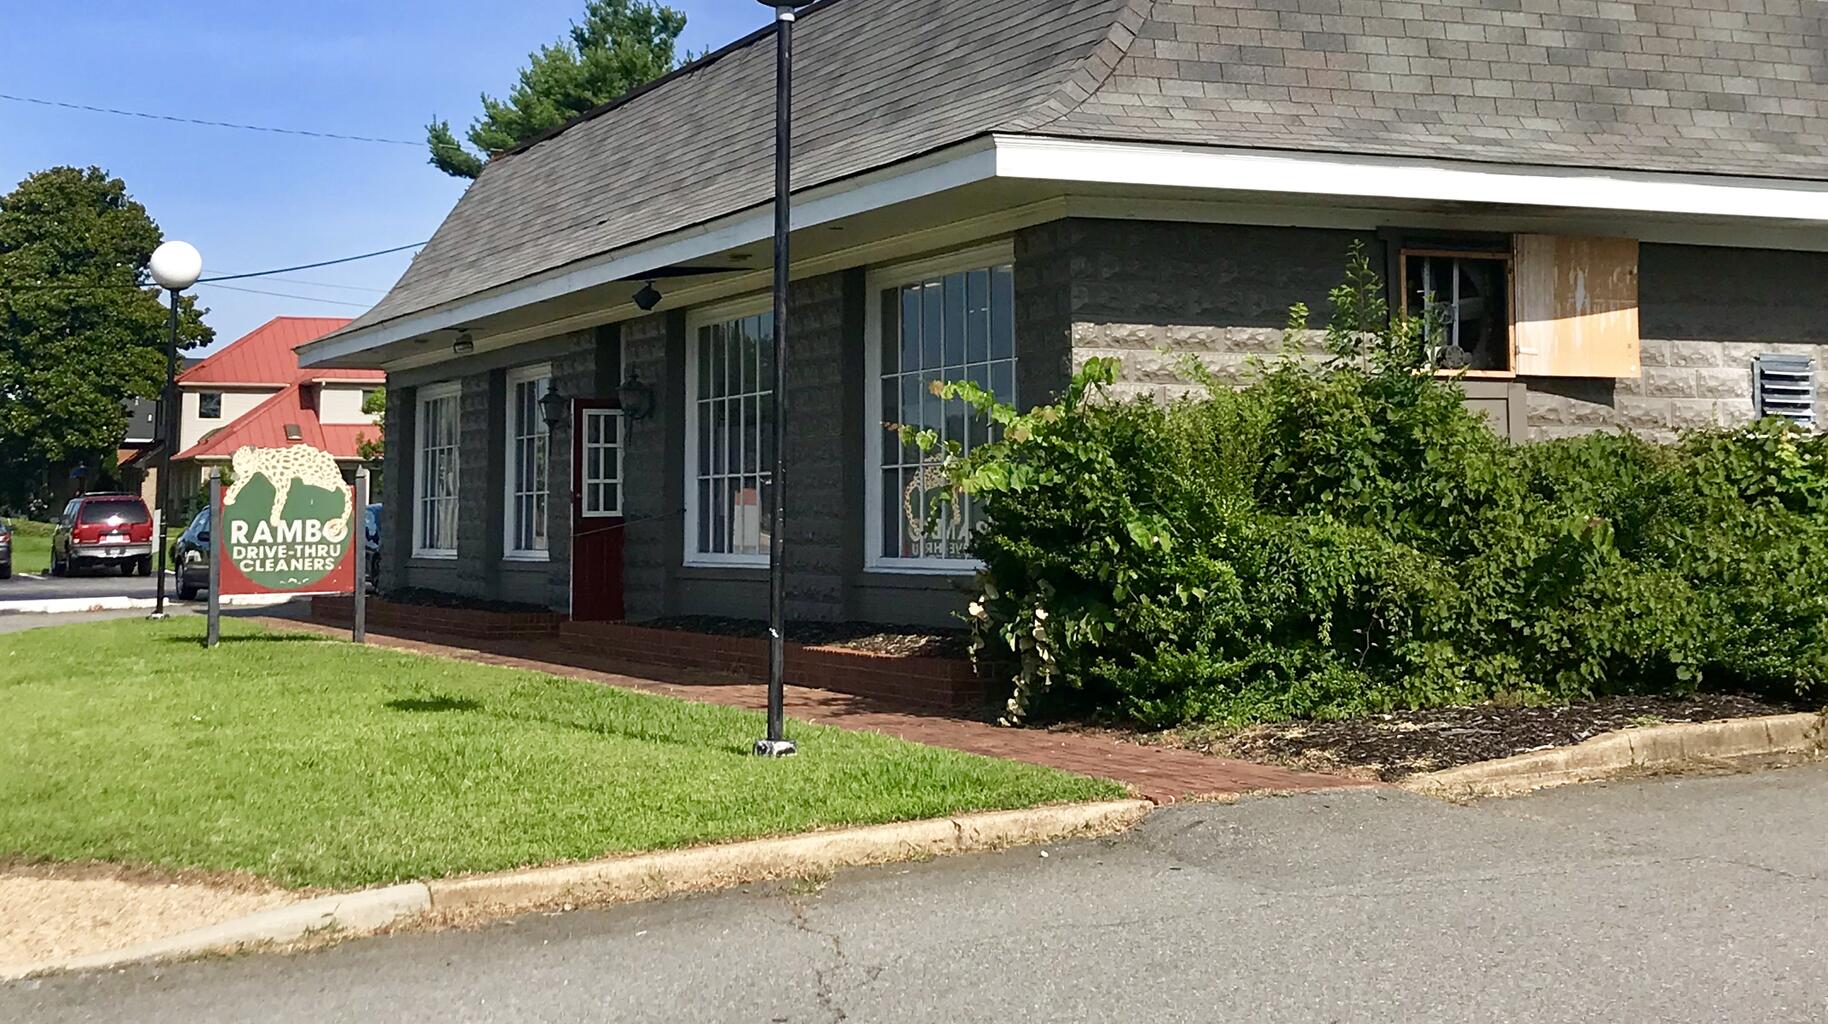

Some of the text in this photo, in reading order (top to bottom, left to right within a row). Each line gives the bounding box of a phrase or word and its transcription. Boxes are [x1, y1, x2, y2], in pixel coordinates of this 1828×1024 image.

[231, 519, 347, 543] RAMBO
[233, 544, 341, 559] DRIVE-THRU
[239, 558, 335, 572] CLEANERS
